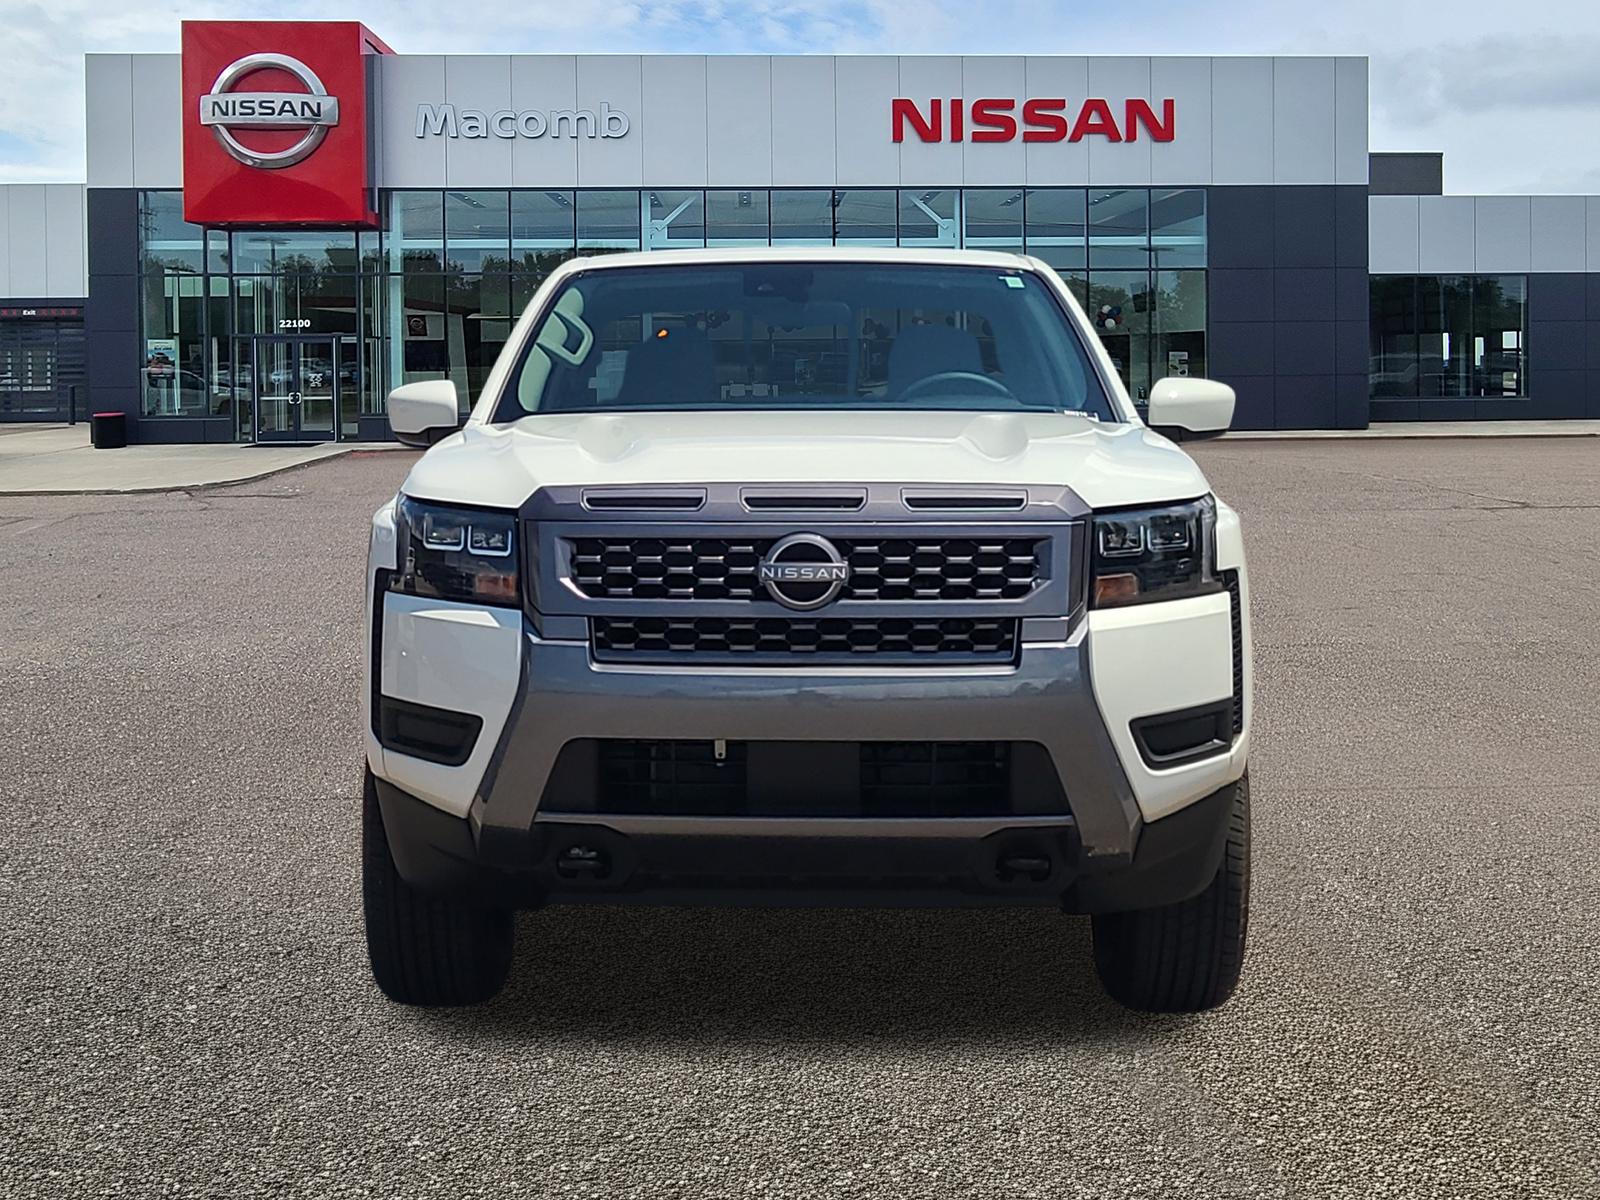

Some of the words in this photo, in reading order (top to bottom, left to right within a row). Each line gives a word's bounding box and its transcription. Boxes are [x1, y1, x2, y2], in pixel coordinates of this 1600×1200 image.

[211, 100, 322, 118] NISSAN
[415, 102, 630, 139] Macomb
[891, 98, 1176, 143] NISSAN
[279, 319, 311, 328] 22100
[761, 567, 846, 579] NISSAN
